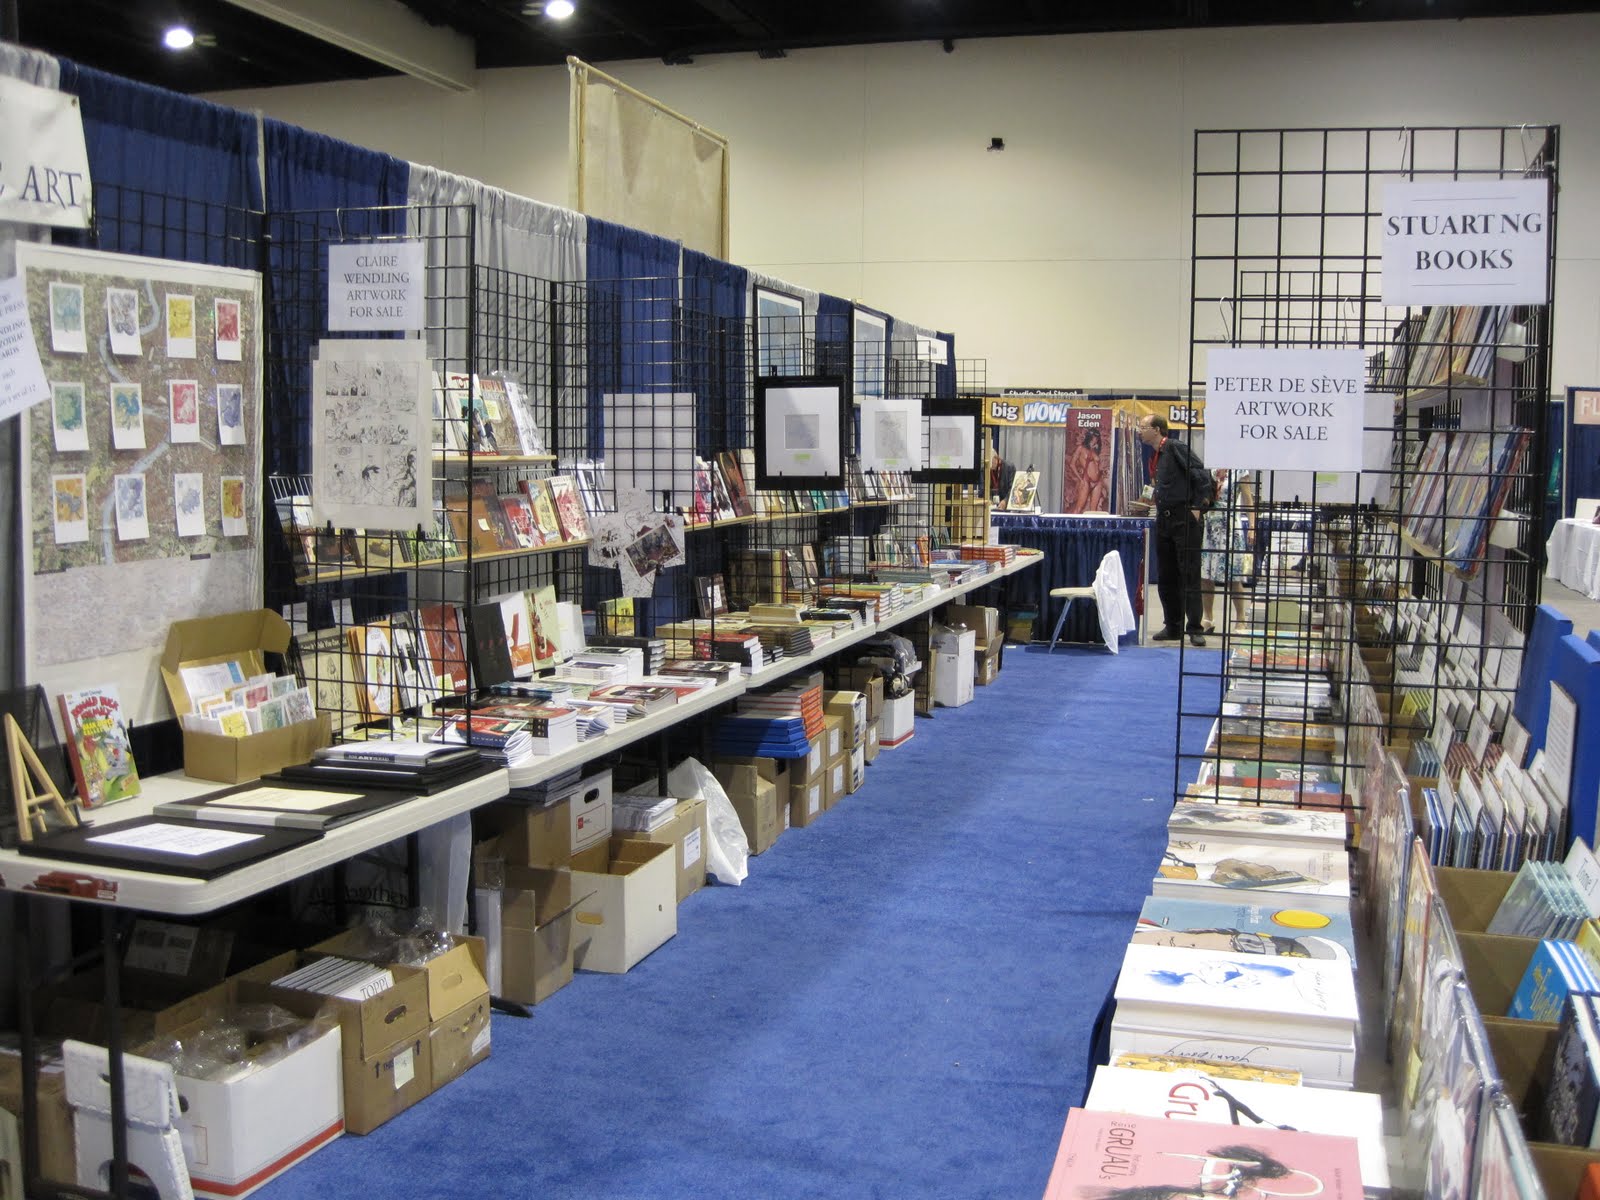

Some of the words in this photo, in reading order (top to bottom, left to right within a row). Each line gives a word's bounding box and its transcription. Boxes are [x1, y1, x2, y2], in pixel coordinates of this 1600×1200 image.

[19, 165, 82, 210] ART
[1387, 214, 1495, 236] STUART
[1501, 213, 1542, 234] NG
[356, 256, 398, 267] CLAIRE
[1416, 249, 1513, 270] BOOKS
[344, 272, 409, 284] WENDLING
[347, 289, 406, 301] ARTWORK
[350, 306, 373, 317] FOR
[376, 306, 404, 317] SALE
[1214, 377, 1274, 392] PETER
[1279, 378, 1305, 393] DE
[1310, 375, 1357, 393] SÈVE
[992, 402, 1018, 421] big
[1077, 411, 1102, 420] Jason
[1169, 405, 1197, 424] big
[1235, 401, 1335, 418] ARTWORK
[1078, 420, 1100, 428] Eden
[1240, 424, 1278, 440] FOR
[1283, 425, 1328, 441] SALE
[360, 976, 389, 1001] TOPPI
